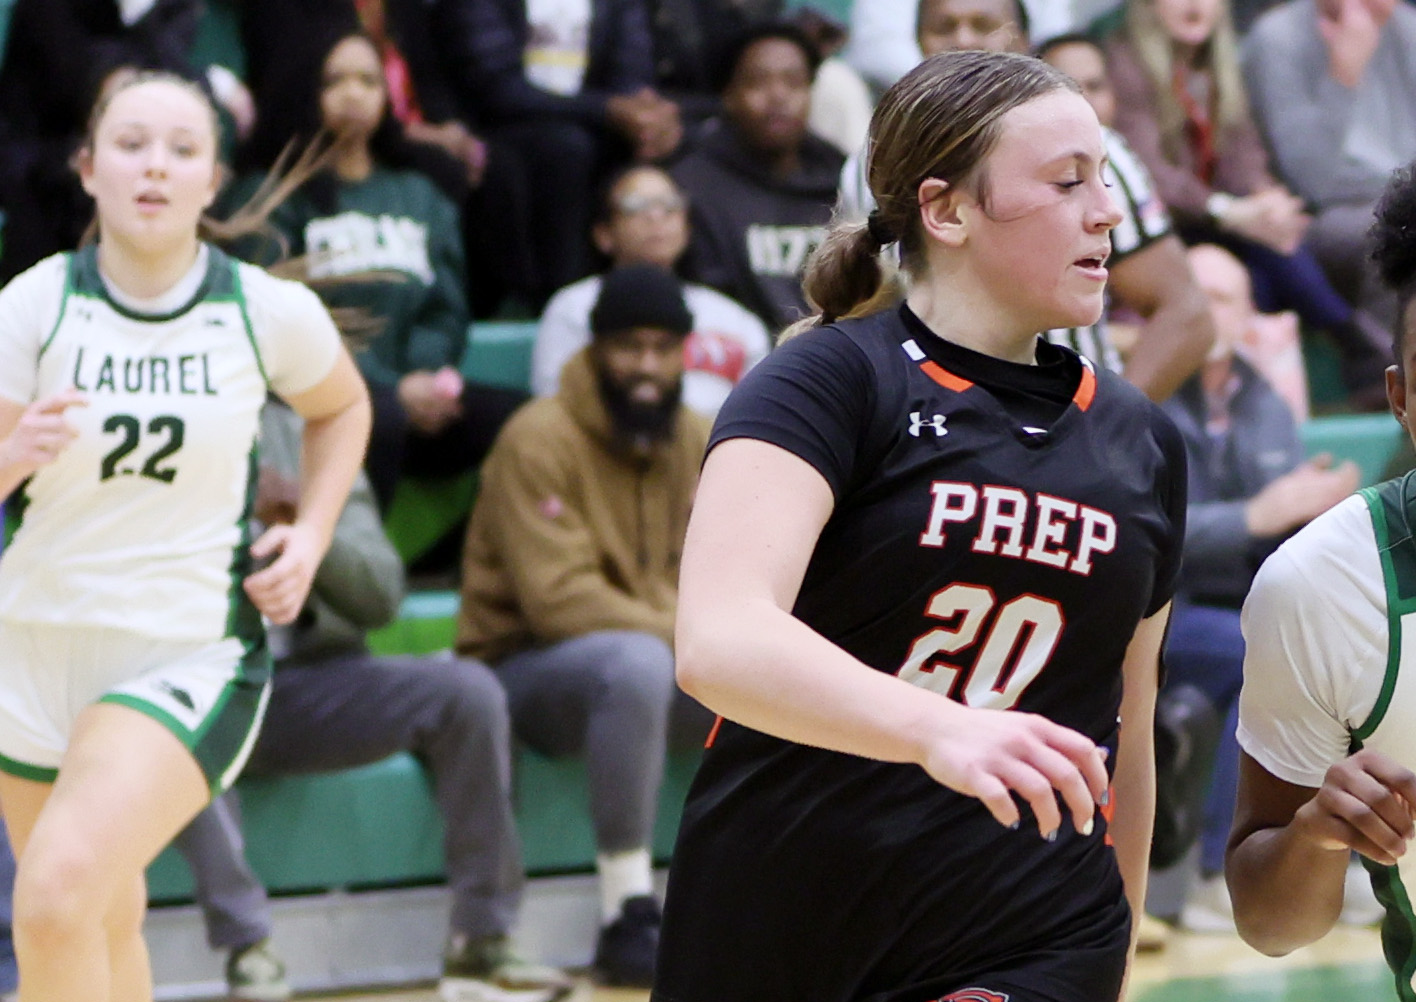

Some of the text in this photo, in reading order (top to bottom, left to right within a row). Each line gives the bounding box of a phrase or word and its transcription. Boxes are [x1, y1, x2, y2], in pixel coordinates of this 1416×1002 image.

[73, 347, 218, 396] LAUREL
[100, 413, 185, 484] 22
[919, 480, 1117, 576] PREP
[896, 581, 1066, 711] 20
